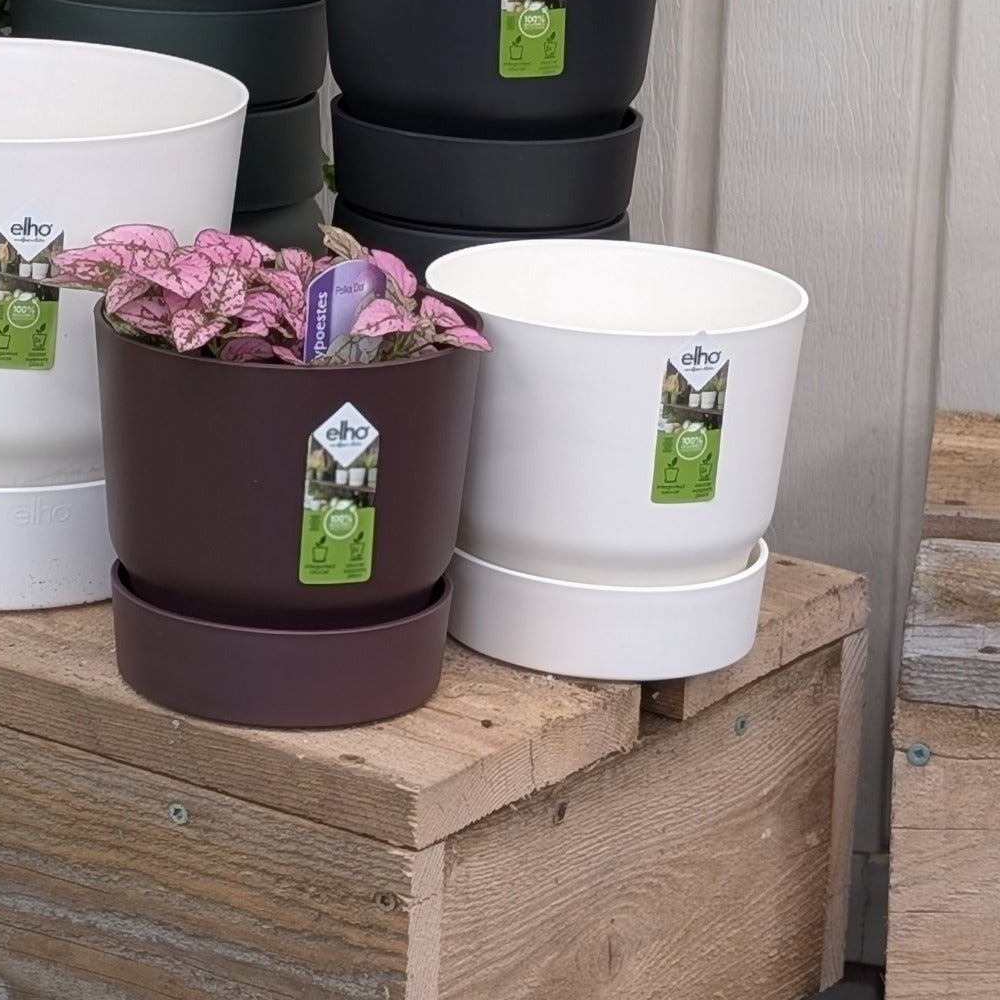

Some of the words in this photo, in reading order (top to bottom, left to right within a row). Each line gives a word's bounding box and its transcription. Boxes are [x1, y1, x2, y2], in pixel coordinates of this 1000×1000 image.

[524, 15, 545, 24] 100%
[10, 217, 53, 236] elho
[335, 286, 352, 296] Polka
[313, 291, 329, 358] ypoestes
[681, 345, 721, 366] elho
[325, 420, 370, 441] elho
[13, 496, 72, 526] elho
